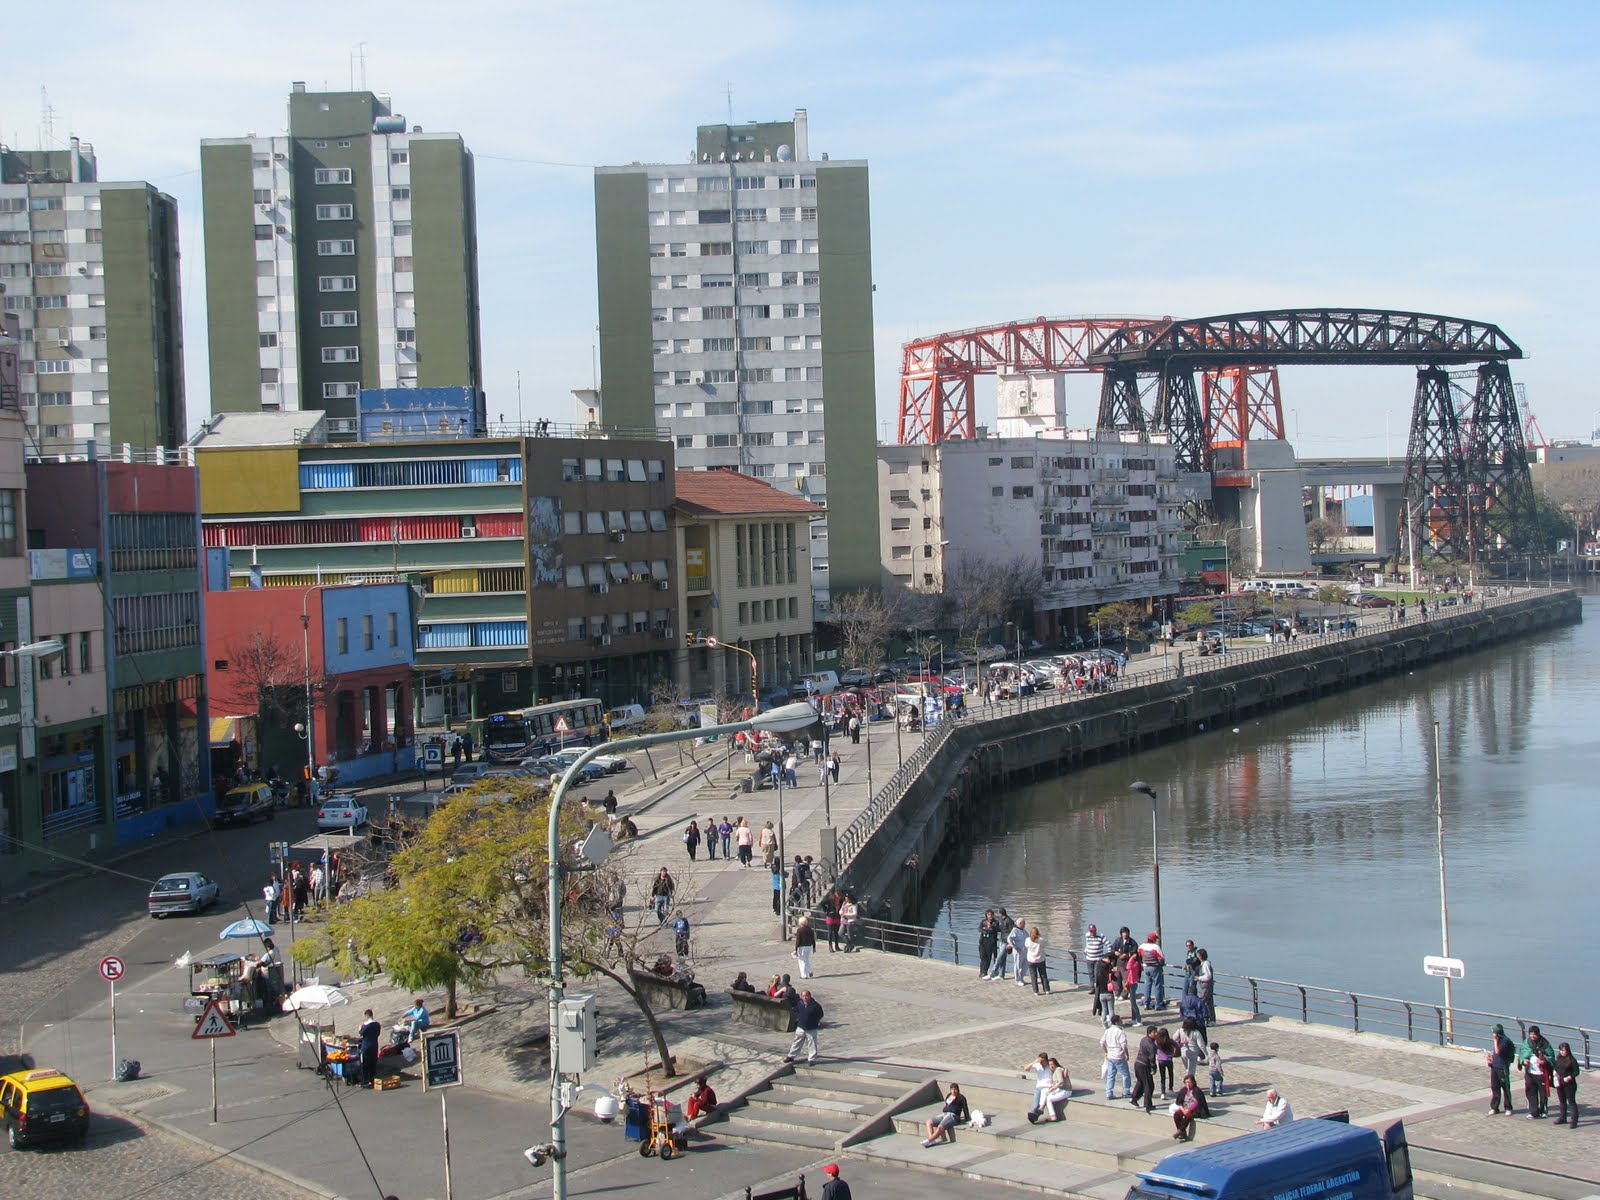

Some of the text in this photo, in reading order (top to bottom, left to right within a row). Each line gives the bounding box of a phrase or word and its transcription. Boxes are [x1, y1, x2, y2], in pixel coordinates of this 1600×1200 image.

[106, 961, 118, 976] E
[1300, 1181, 1326, 1197] FEDERAL
[1326, 1171, 1360, 1189] ARGENTINA
